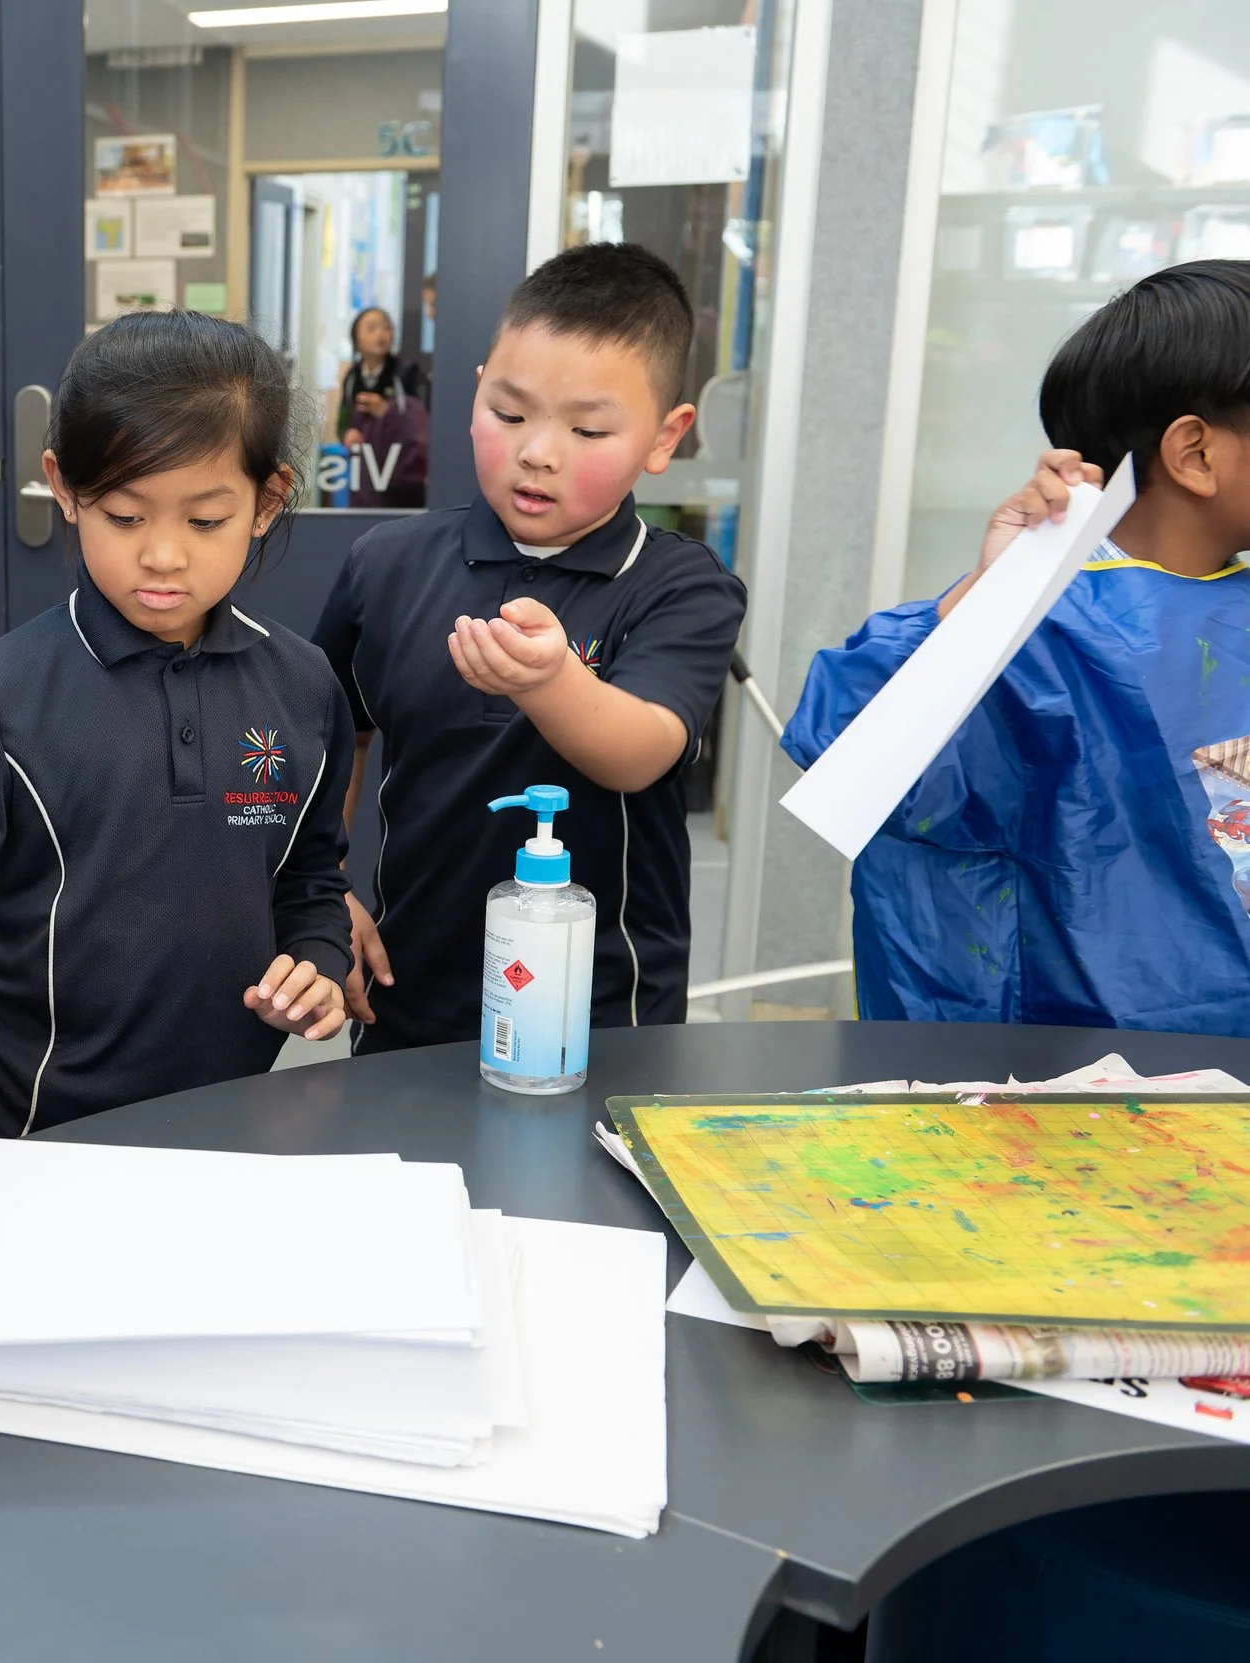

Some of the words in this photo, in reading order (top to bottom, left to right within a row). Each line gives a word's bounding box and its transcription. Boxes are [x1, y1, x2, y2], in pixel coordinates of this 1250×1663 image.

[224, 791, 299, 805] RESURRECTION
[243, 803, 277, 815] CATHOLIC
[227, 814, 264, 826] PRIMARY
[264, 813, 287, 825] SCHOOL
[923, 1323, 951, 1354] 00
